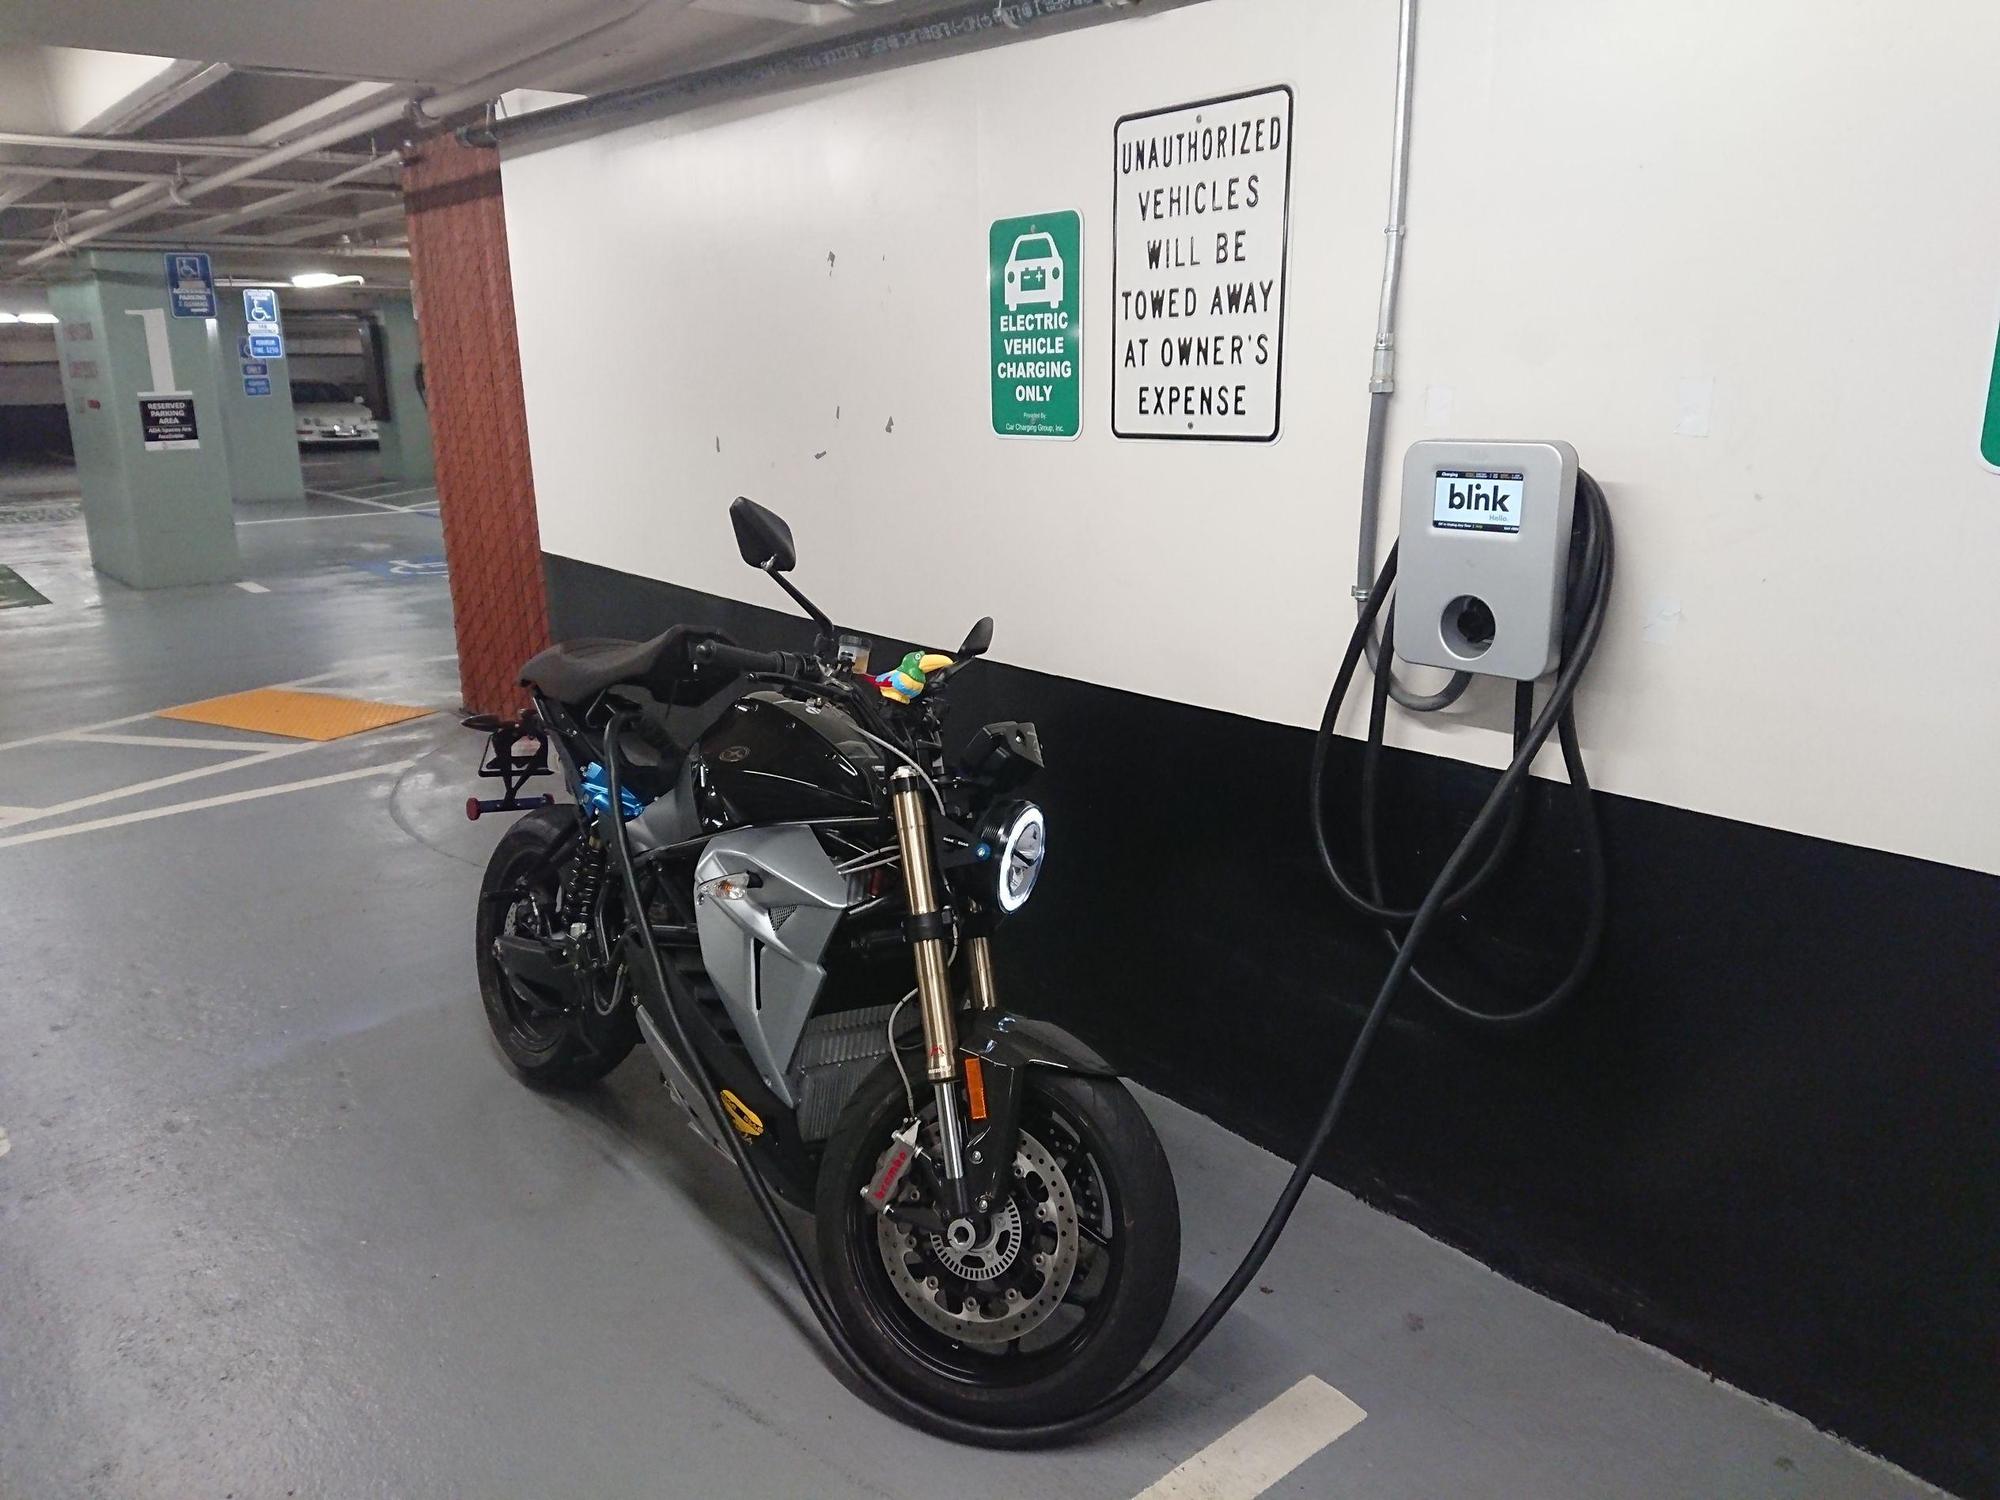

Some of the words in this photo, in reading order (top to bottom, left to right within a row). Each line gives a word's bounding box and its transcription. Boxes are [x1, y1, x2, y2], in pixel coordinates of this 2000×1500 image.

[1122, 116, 1282, 174] UNAUTHORIZED
[1138, 175, 1260, 221] VEHICLES
[1147, 236, 1201, 270] WILL
[1216, 230, 1247, 264] BE
[1122, 287, 1197, 321] TOWED
[1210, 280, 1274, 315] AWAY
[1000, 312, 1069, 332] ELECTRIC
[1004, 337, 1065, 355] VEHICLE
[1124, 339, 1149, 368] AT
[1161, 333, 1269, 367] OWNER'S
[997, 361, 1072, 379] CHARGING
[1015, 385, 1052, 402] ONLY
[1138, 384, 1247, 416] EXPENSE
[1015, 423, 1037, 432] Charging
[1038, 424, 1054, 432] Group,
[1448, 483, 1511, 512] blink
[873, 1151, 907, 1200] brembo
